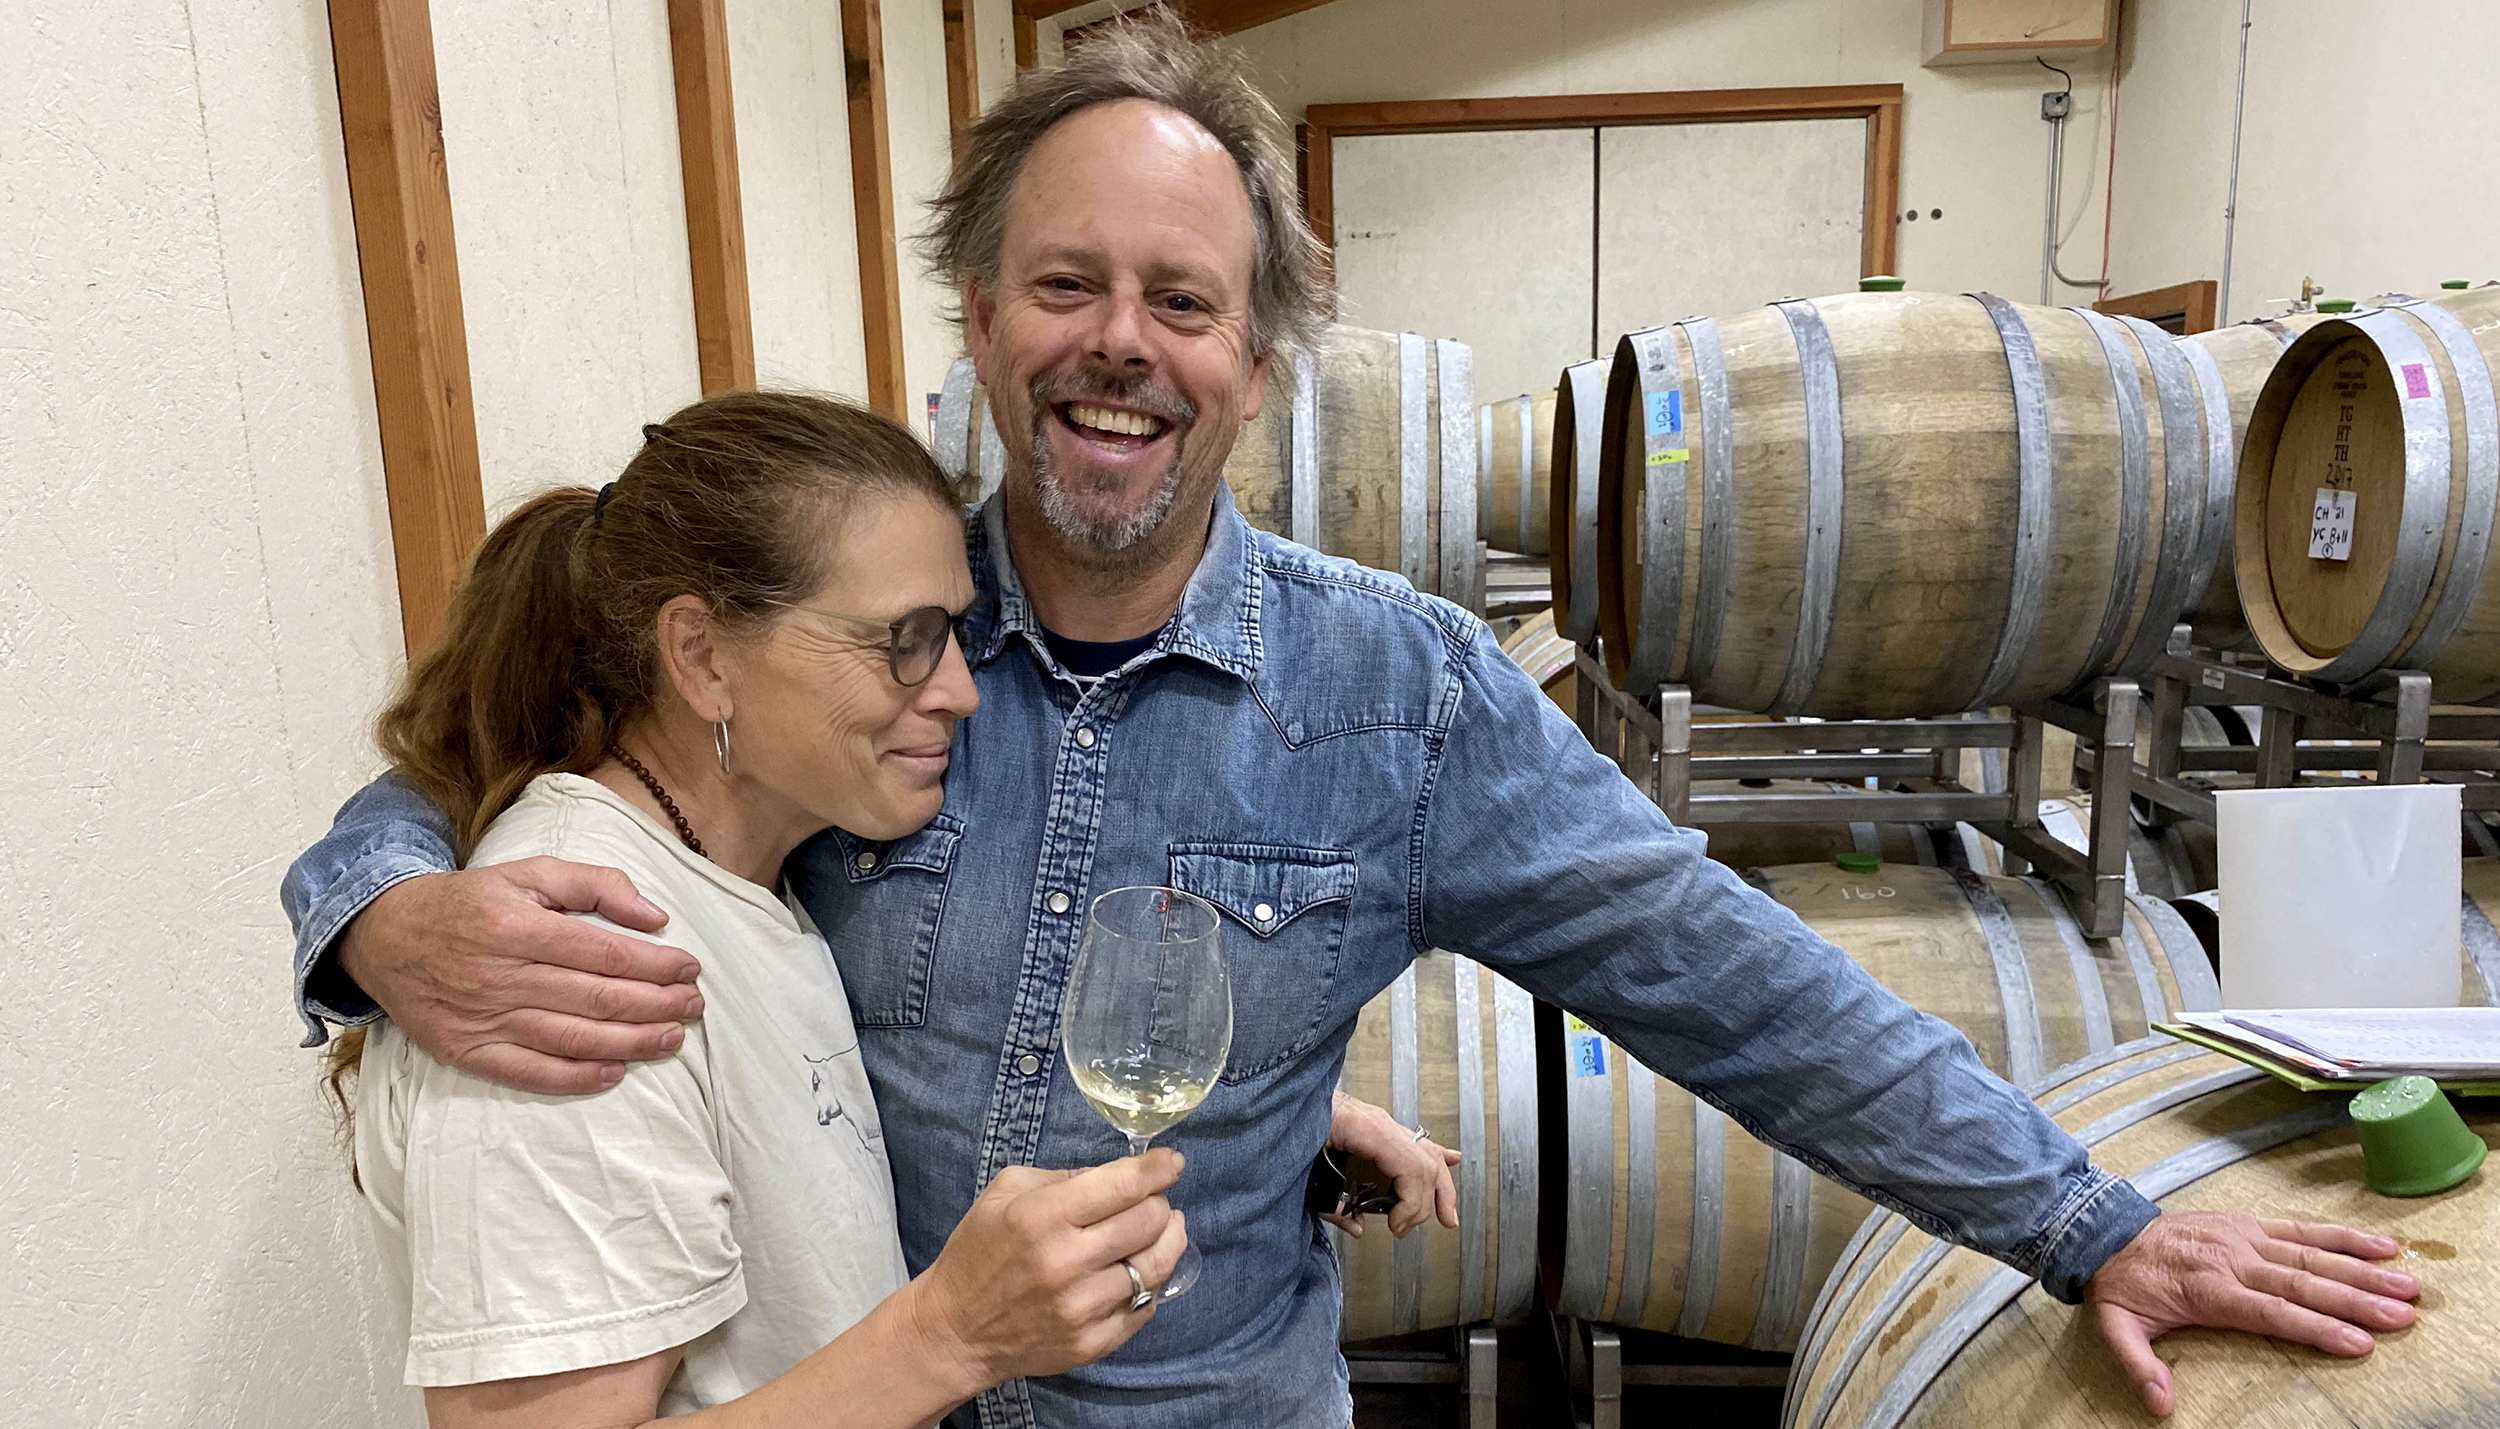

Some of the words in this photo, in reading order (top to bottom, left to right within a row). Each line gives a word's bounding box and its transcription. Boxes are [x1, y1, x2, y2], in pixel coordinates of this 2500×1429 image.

[2336, 424, 2352, 442] HT
[2335, 444, 2350, 461] TH
[2315, 506, 2329, 520] CH
[1841, 886, 1896, 900] 160
